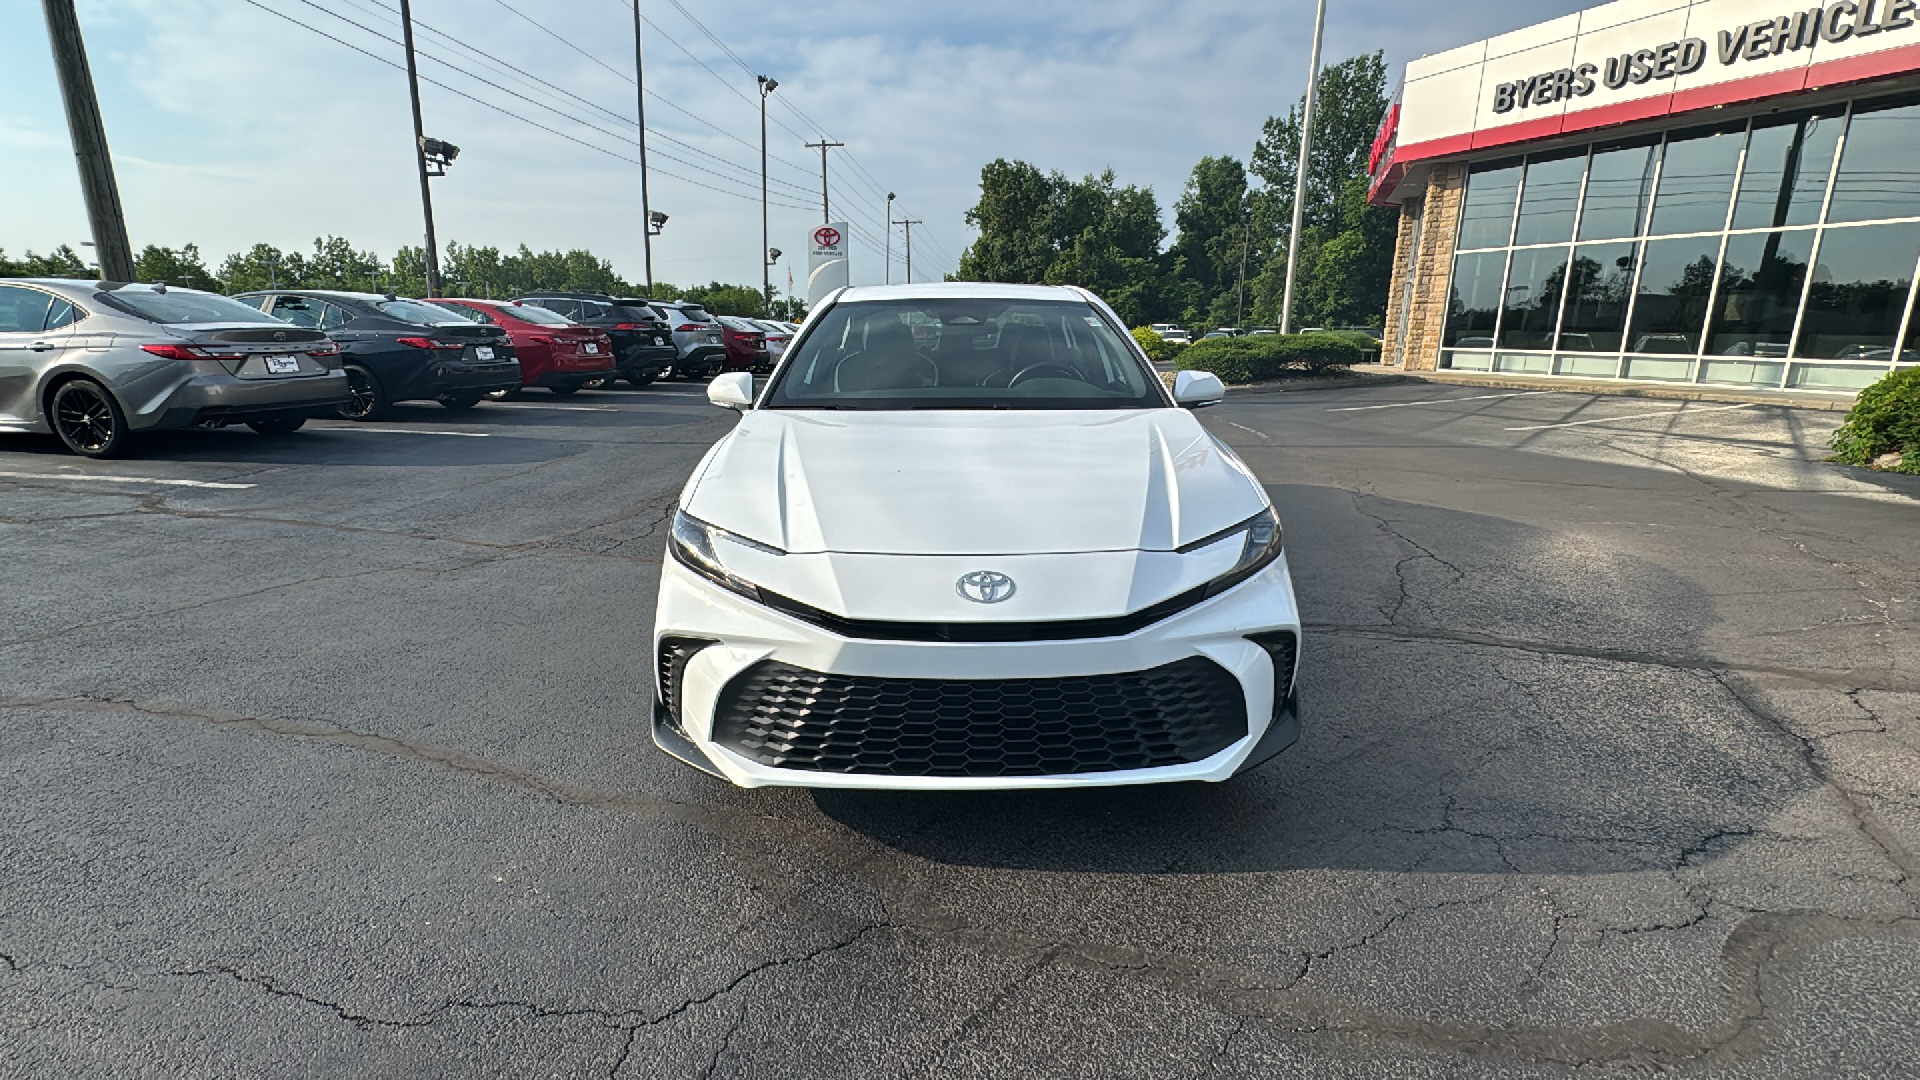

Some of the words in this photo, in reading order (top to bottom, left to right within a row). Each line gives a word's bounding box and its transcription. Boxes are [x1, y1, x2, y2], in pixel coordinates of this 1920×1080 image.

[1492, 62, 1598, 114] BYERS
[1602, 37, 1706, 90] USED
[1717, 0, 1920, 66] VEHICLE
